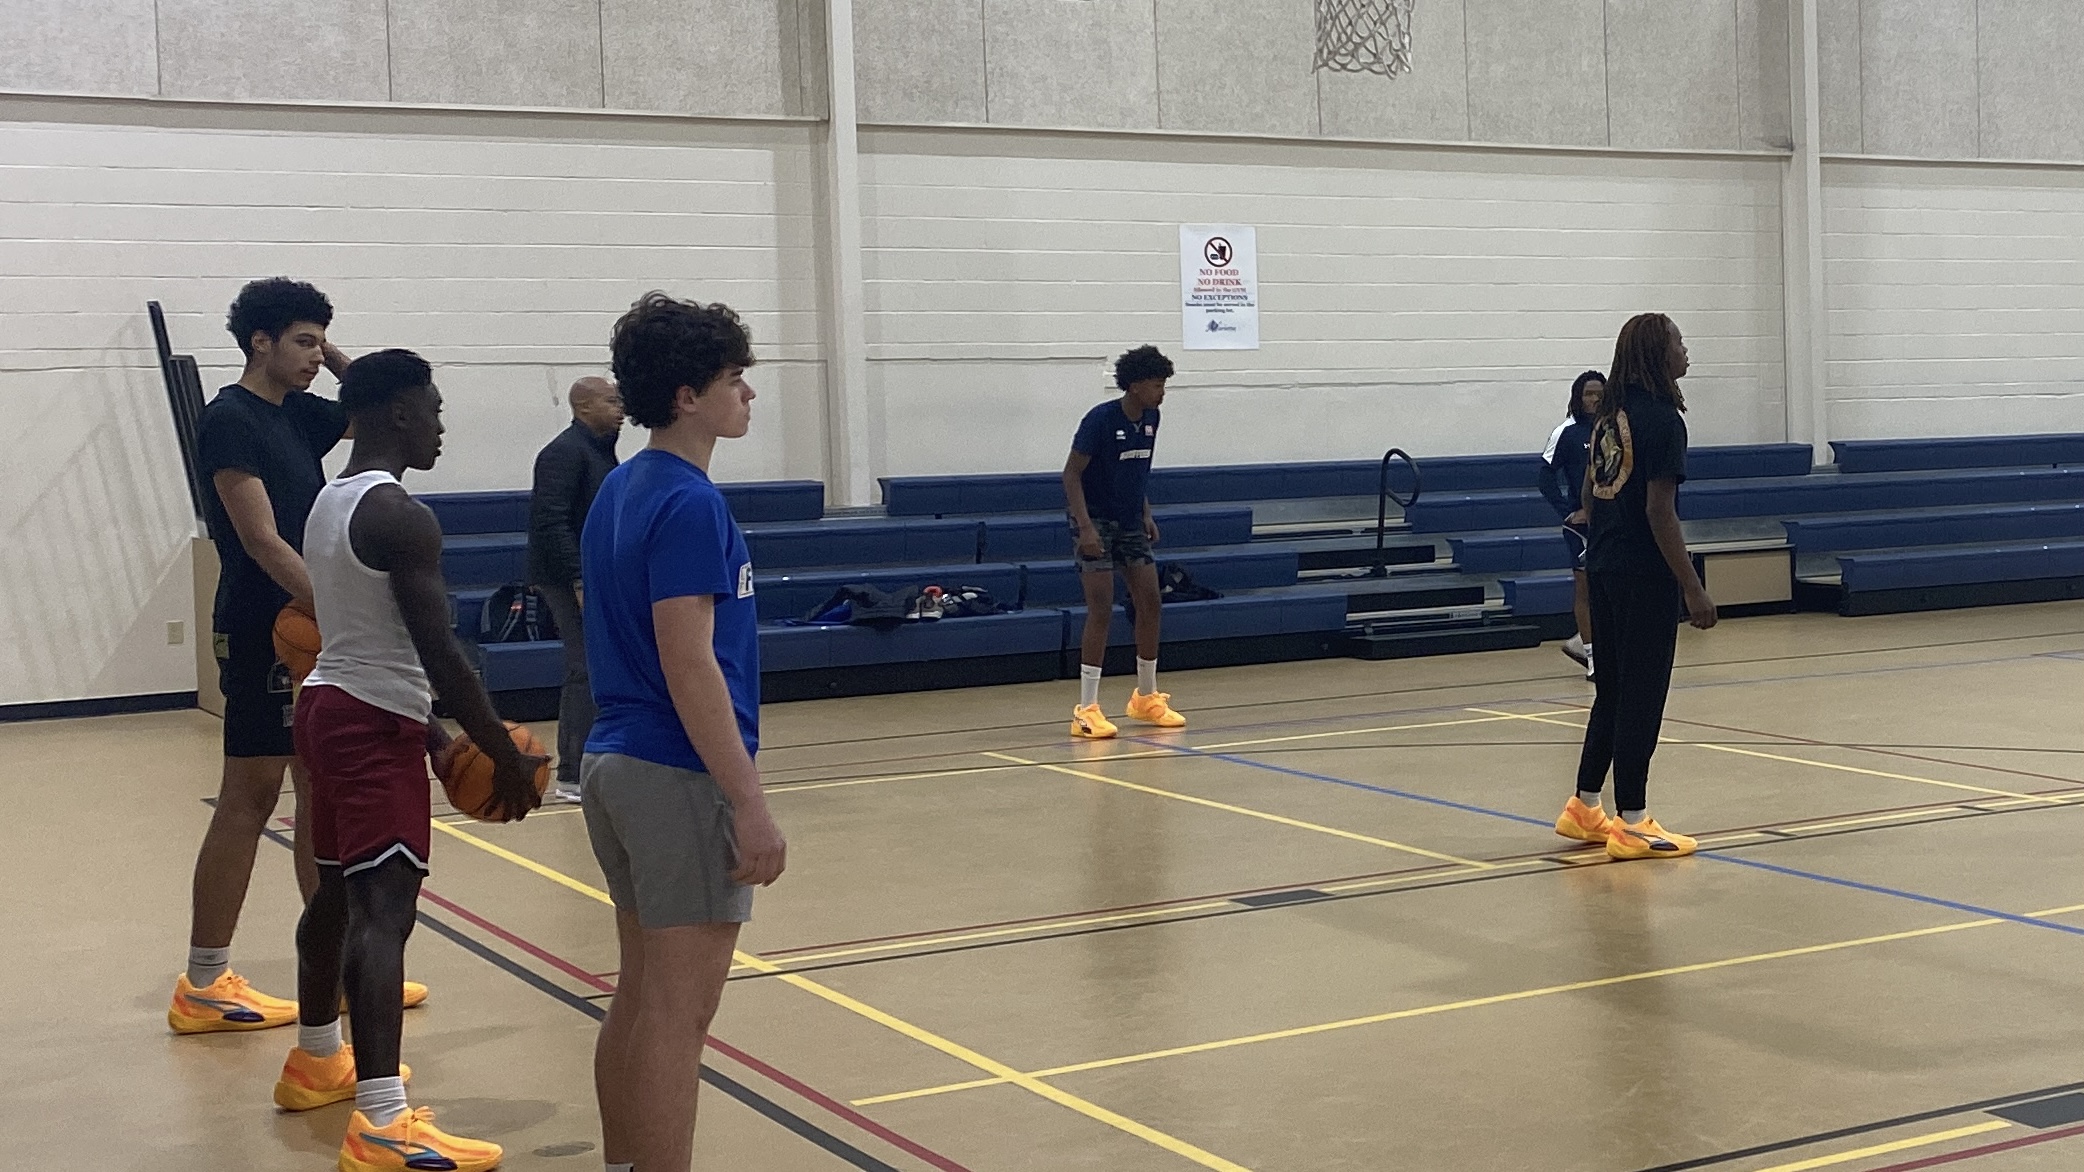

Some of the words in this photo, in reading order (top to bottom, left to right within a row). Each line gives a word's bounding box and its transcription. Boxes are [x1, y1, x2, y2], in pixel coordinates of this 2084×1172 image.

[1199, 268, 1213, 276] NO
[1214, 268, 1240, 276] FOOD
[1197, 278, 1211, 286] NO
[1212, 278, 1242, 286] DRINK
